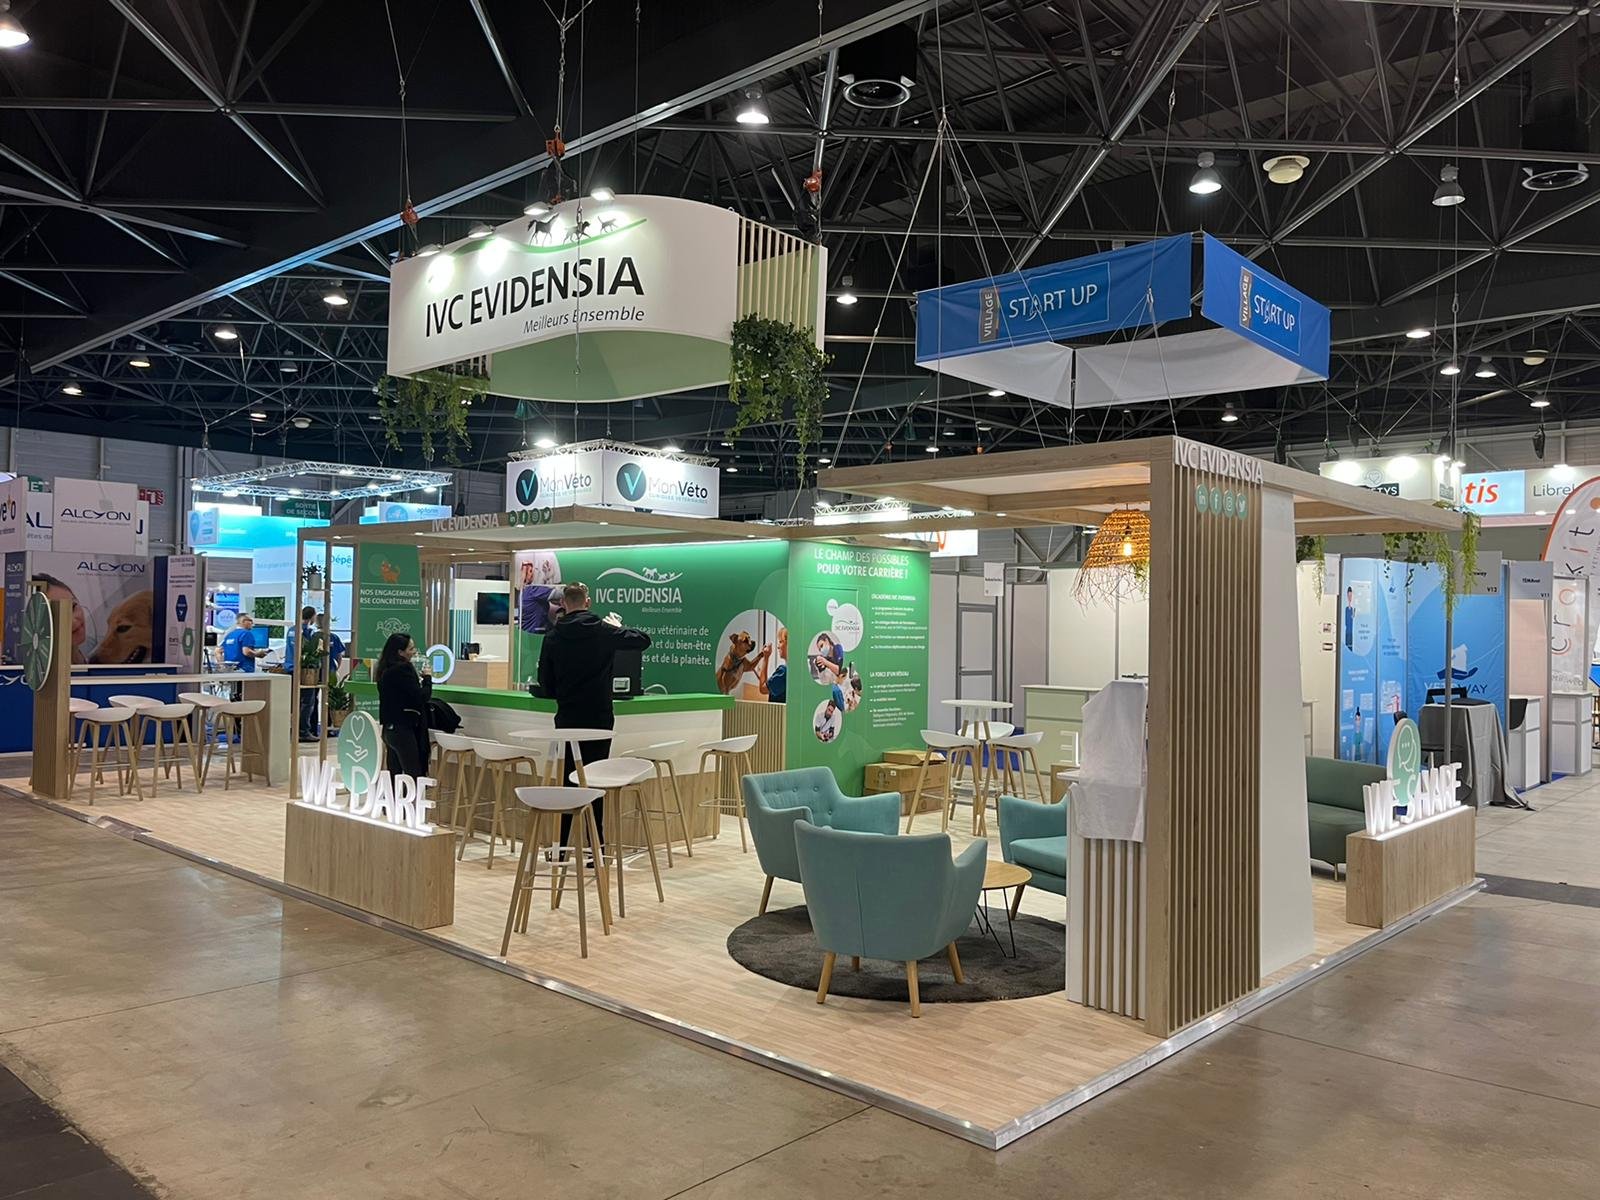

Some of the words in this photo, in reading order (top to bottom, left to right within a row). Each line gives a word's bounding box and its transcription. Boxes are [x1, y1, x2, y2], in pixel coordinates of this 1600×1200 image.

[426, 293, 464, 338] IVC
[470, 256, 646, 325] EVIDENSIA
[1071, 284, 1098, 306] UP
[1242, 275, 1250, 321] VILLAGE
[523, 310, 569, 334] Meilleurs
[571, 305, 646, 325] Ensemble
[984, 292, 994, 338] VILLAGE
[1282, 310, 1295, 332] UP
[1174, 439, 1199, 470] IVC
[1200, 447, 1263, 484] EVIDENSIA
[649, 477, 708, 499] MonVéto
[60, 508, 131, 521] ALCYON
[431, 519, 448, 533] IVC
[448, 512, 500, 531] EVIDENSIA
[77, 561, 145, 573] ALCYON
[814, 548, 824, 560] LE
[825, 549, 854, 562] CHAMP
[856, 551, 870, 563] DES
[872, 552, 910, 567] POSSIBLES
[816, 562, 840, 575] POUR
[841, 564, 867, 577] VOTRE
[360, 588, 374, 596] NOS
[375, 589, 420, 597] ENGAGEMENTS
[595, 587, 614, 604] IVC
[616, 587, 682, 604] EVIDENSIA
[657, 626, 697, 636] vétérinaire
[698, 626, 710, 636] de
[656, 641, 663, 649] et
[664, 641, 675, 649] du
[676, 640, 711, 651] bien-être
[651, 654, 659, 663] et
[660, 654, 670, 663] de
[671, 654, 679, 664] la
[680, 655, 712, 666] planète.
[301, 757, 346, 810] WE
[350, 766, 438, 833] DARE
